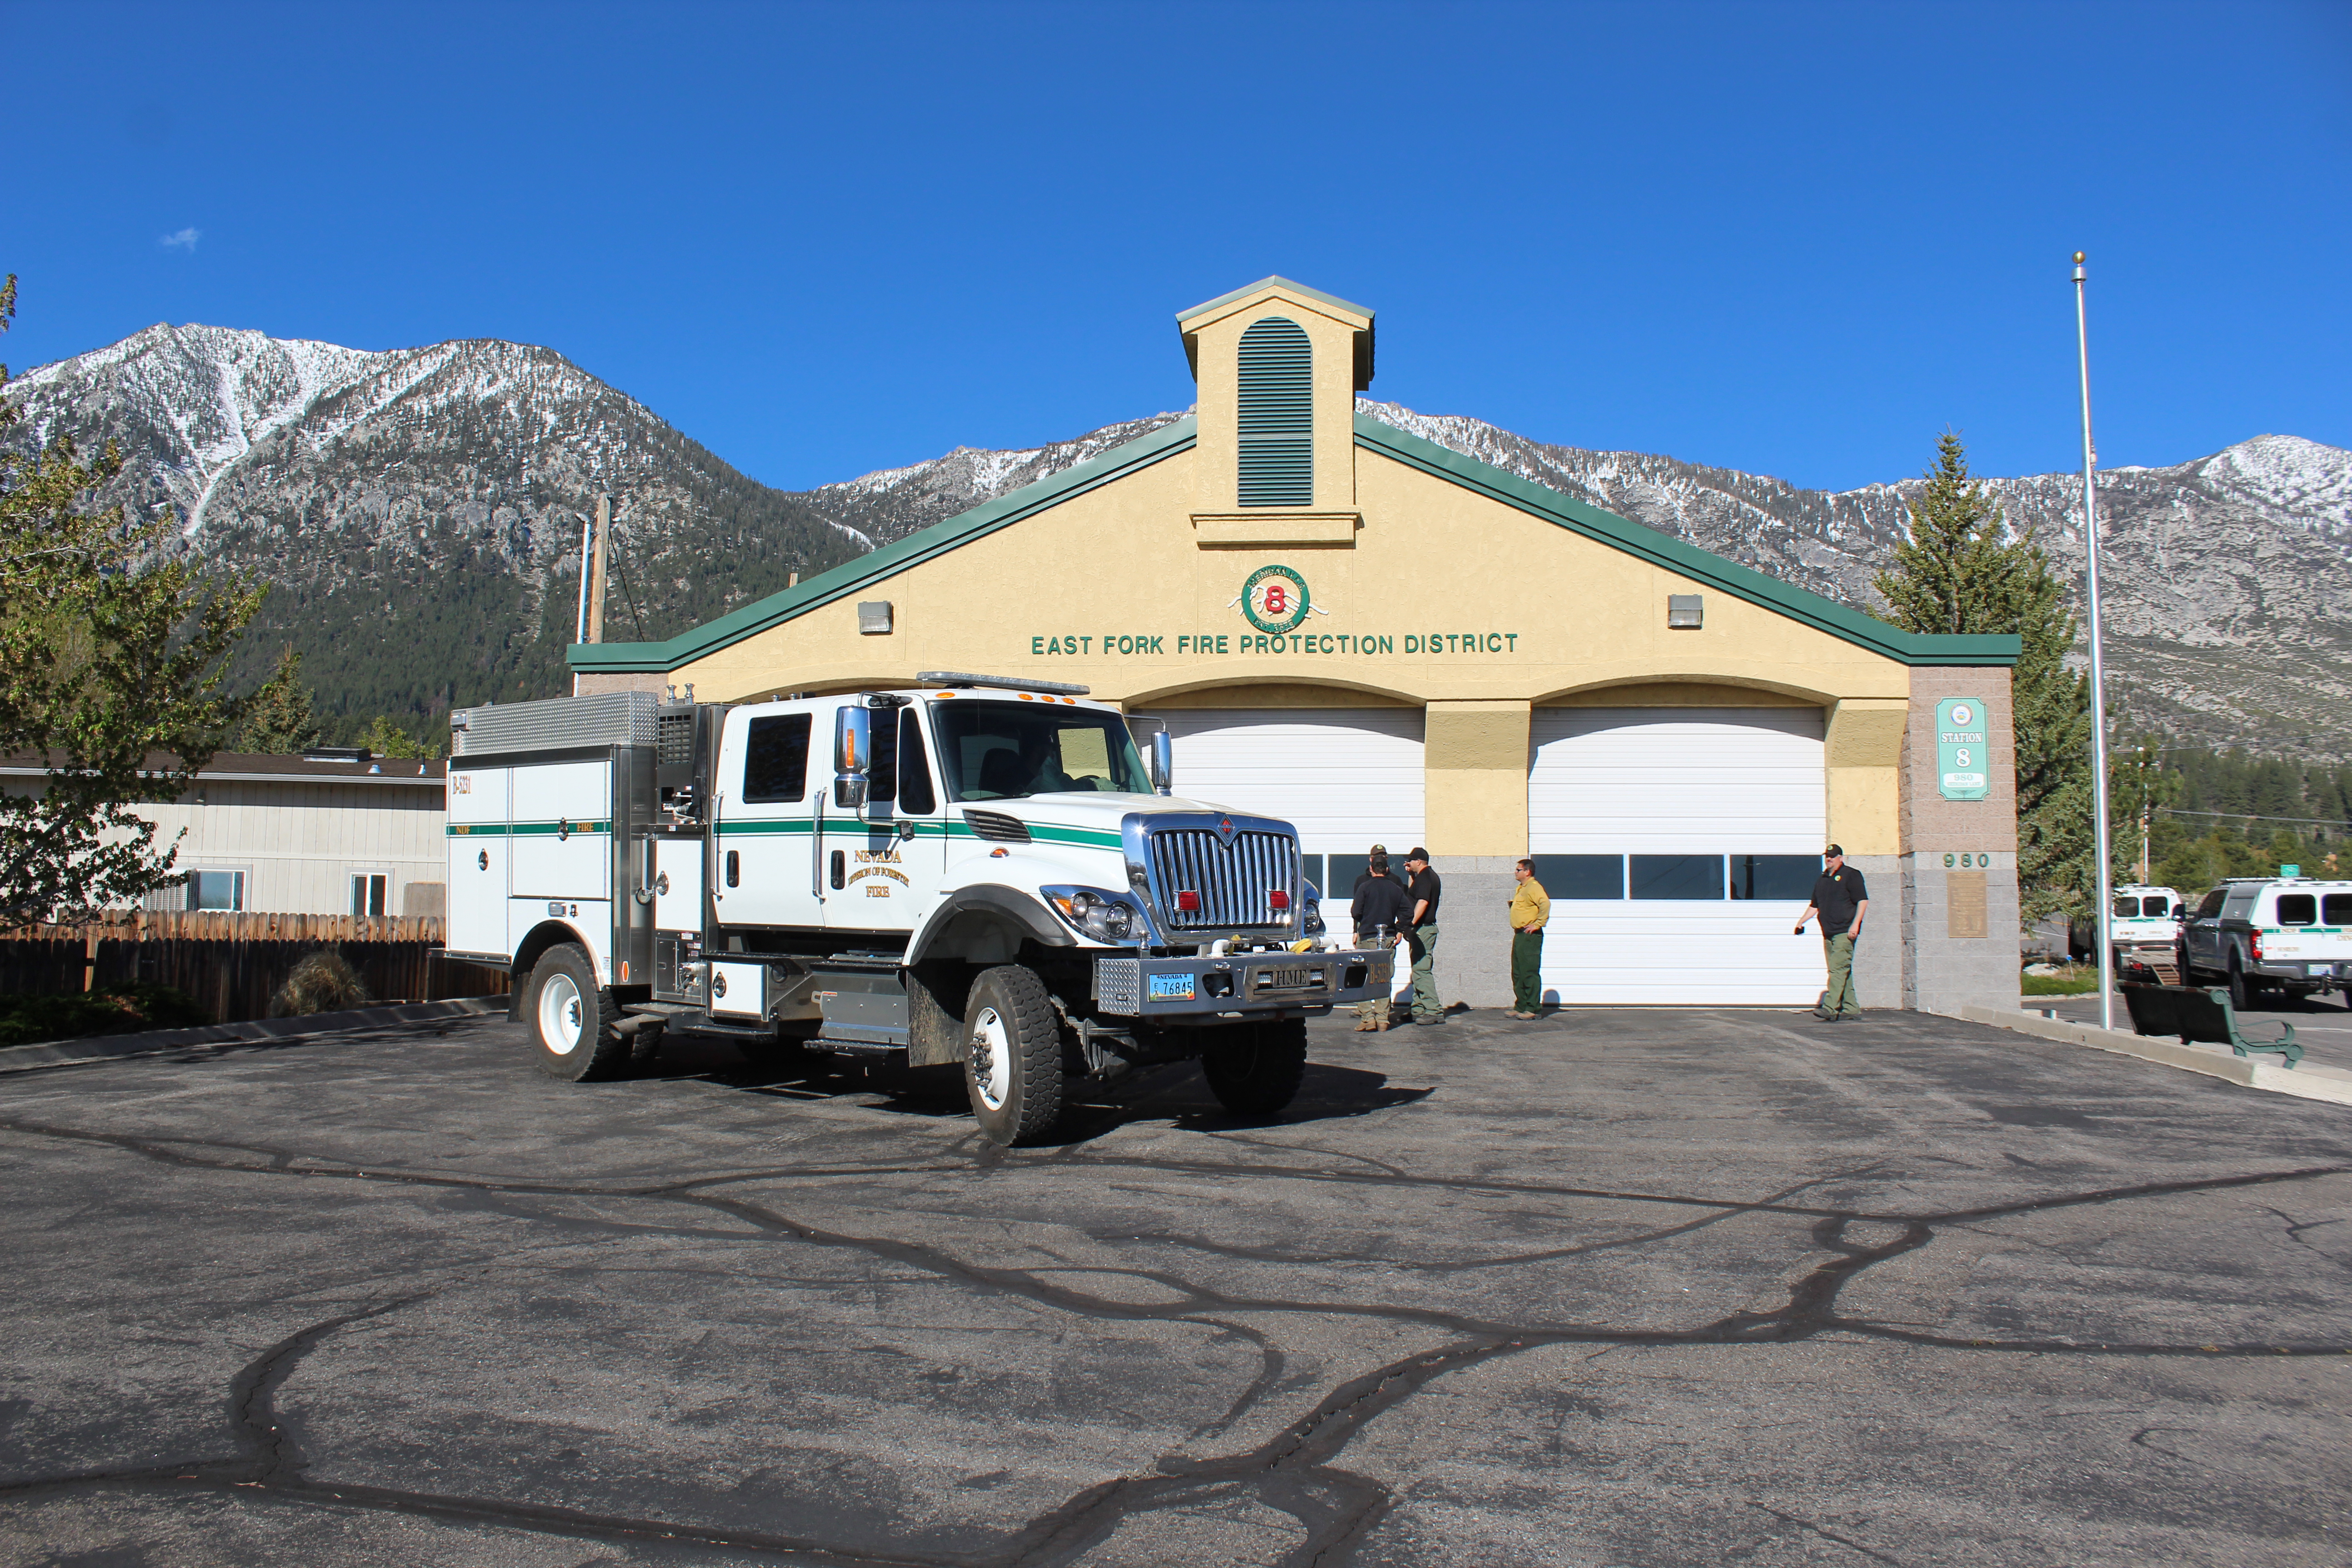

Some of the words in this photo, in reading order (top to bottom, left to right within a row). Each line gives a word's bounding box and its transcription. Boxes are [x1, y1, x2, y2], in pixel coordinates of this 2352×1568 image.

[1246, 567, 1287, 589] SHERIDAN
[1265, 585, 1286, 612] 8
[1032, 635, 1093, 654] EAST
[1104, 635, 1164, 654] FORK
[1179, 635, 1229, 654] FIRE
[1240, 634, 1393, 654] PROTECTION
[1405, 633, 1518, 653] DISTRICT
[1941, 732, 1983, 743] STATION
[1955, 747, 1971, 768] 8
[452, 775, 471, 794] B-5231
[456, 826, 470, 834] NDF
[576, 822, 594, 832] FIRE
[854, 850, 902, 863] NEVADA
[1943, 853, 1989, 867] 980
[872, 867, 880, 876] OF
[881, 867, 909, 888] FORESTRY
[866, 886, 890, 897] FIRE
[1276, 969, 1307, 985] HME
[1369, 963, 1390, 984] B-5231
[1163, 981, 1192, 995] 76845
